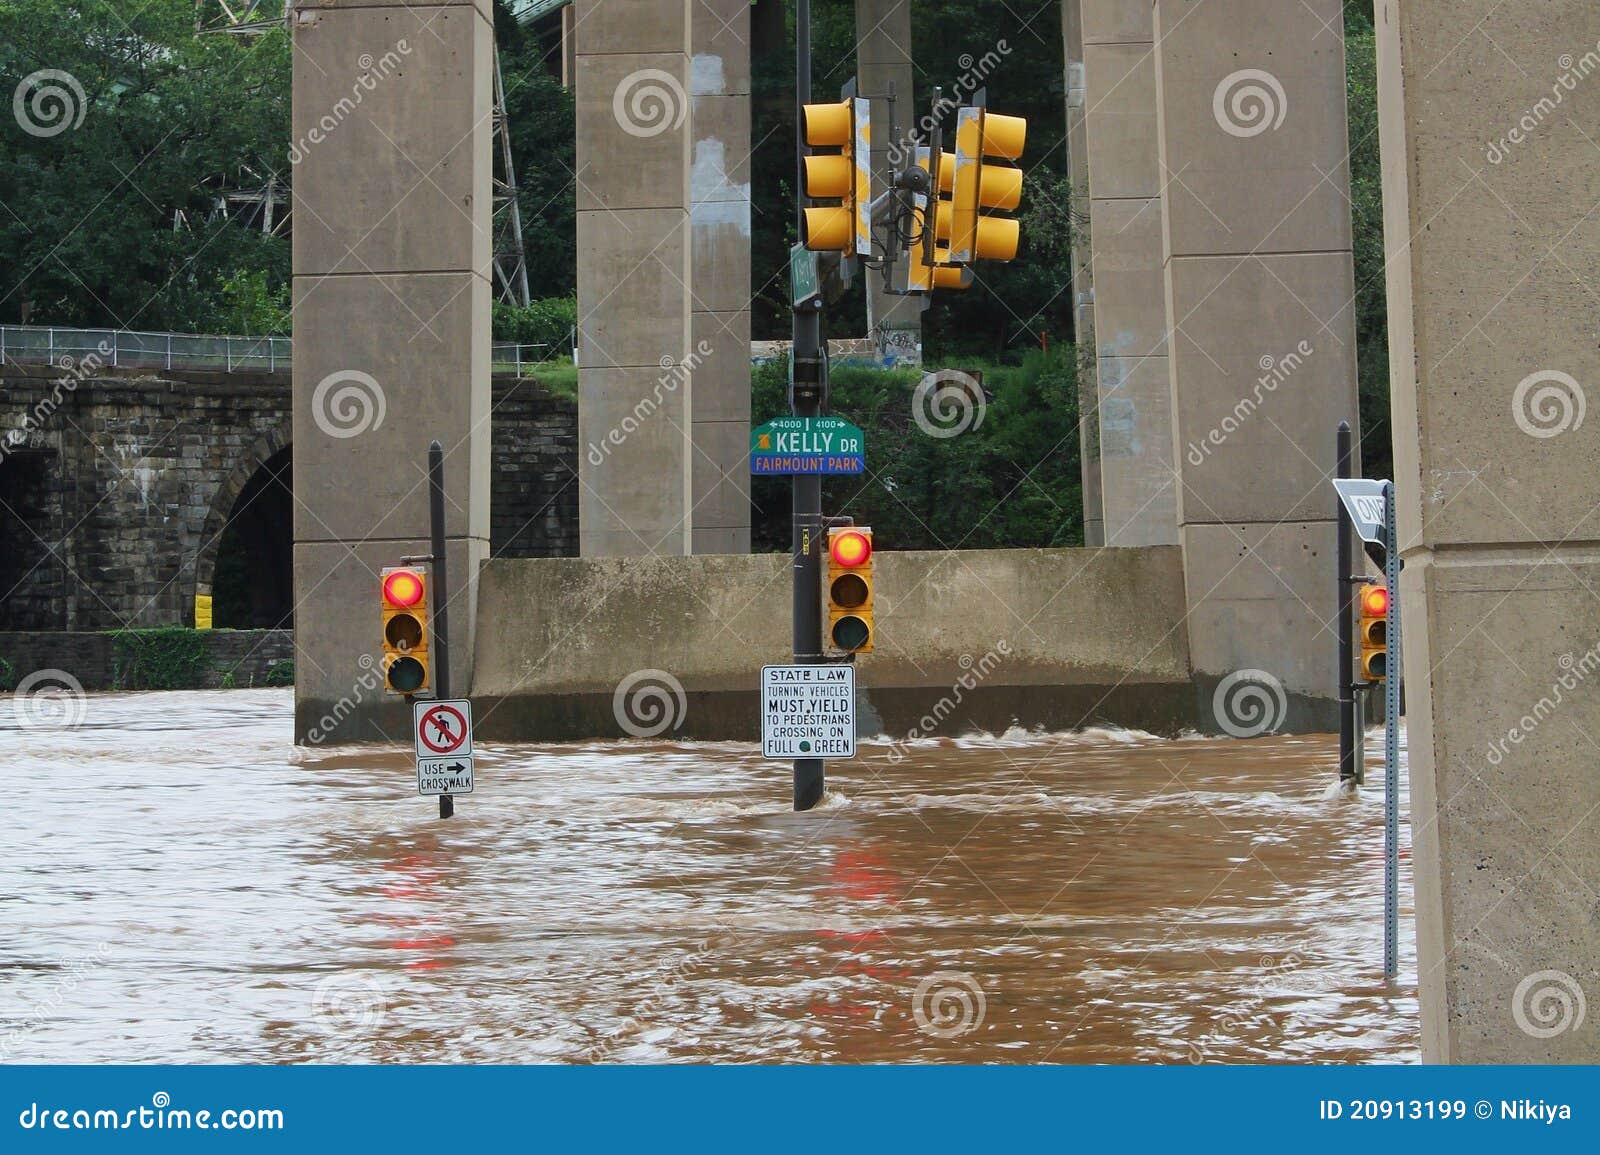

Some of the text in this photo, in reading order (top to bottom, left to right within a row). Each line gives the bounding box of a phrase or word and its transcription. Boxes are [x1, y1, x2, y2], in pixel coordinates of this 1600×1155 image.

[779, 420, 836, 429] 4000 4100
[776, 432, 858, 453] KELLY DR
[756, 457, 859, 472] FAIRMOUNT PARK
[770, 670, 846, 681] STATE LAW
[768, 686, 850, 697] TURNING VEHICLES
[769, 699, 848, 713] MUST YIELD
[767, 714, 850, 726] TO PEDESTRIANS
[773, 727, 844, 738] CROSSING ON
[768, 739, 849, 753] FULL GREEN
[424, 763, 445, 775] USE
[421, 776, 471, 790] CROSSWALK
